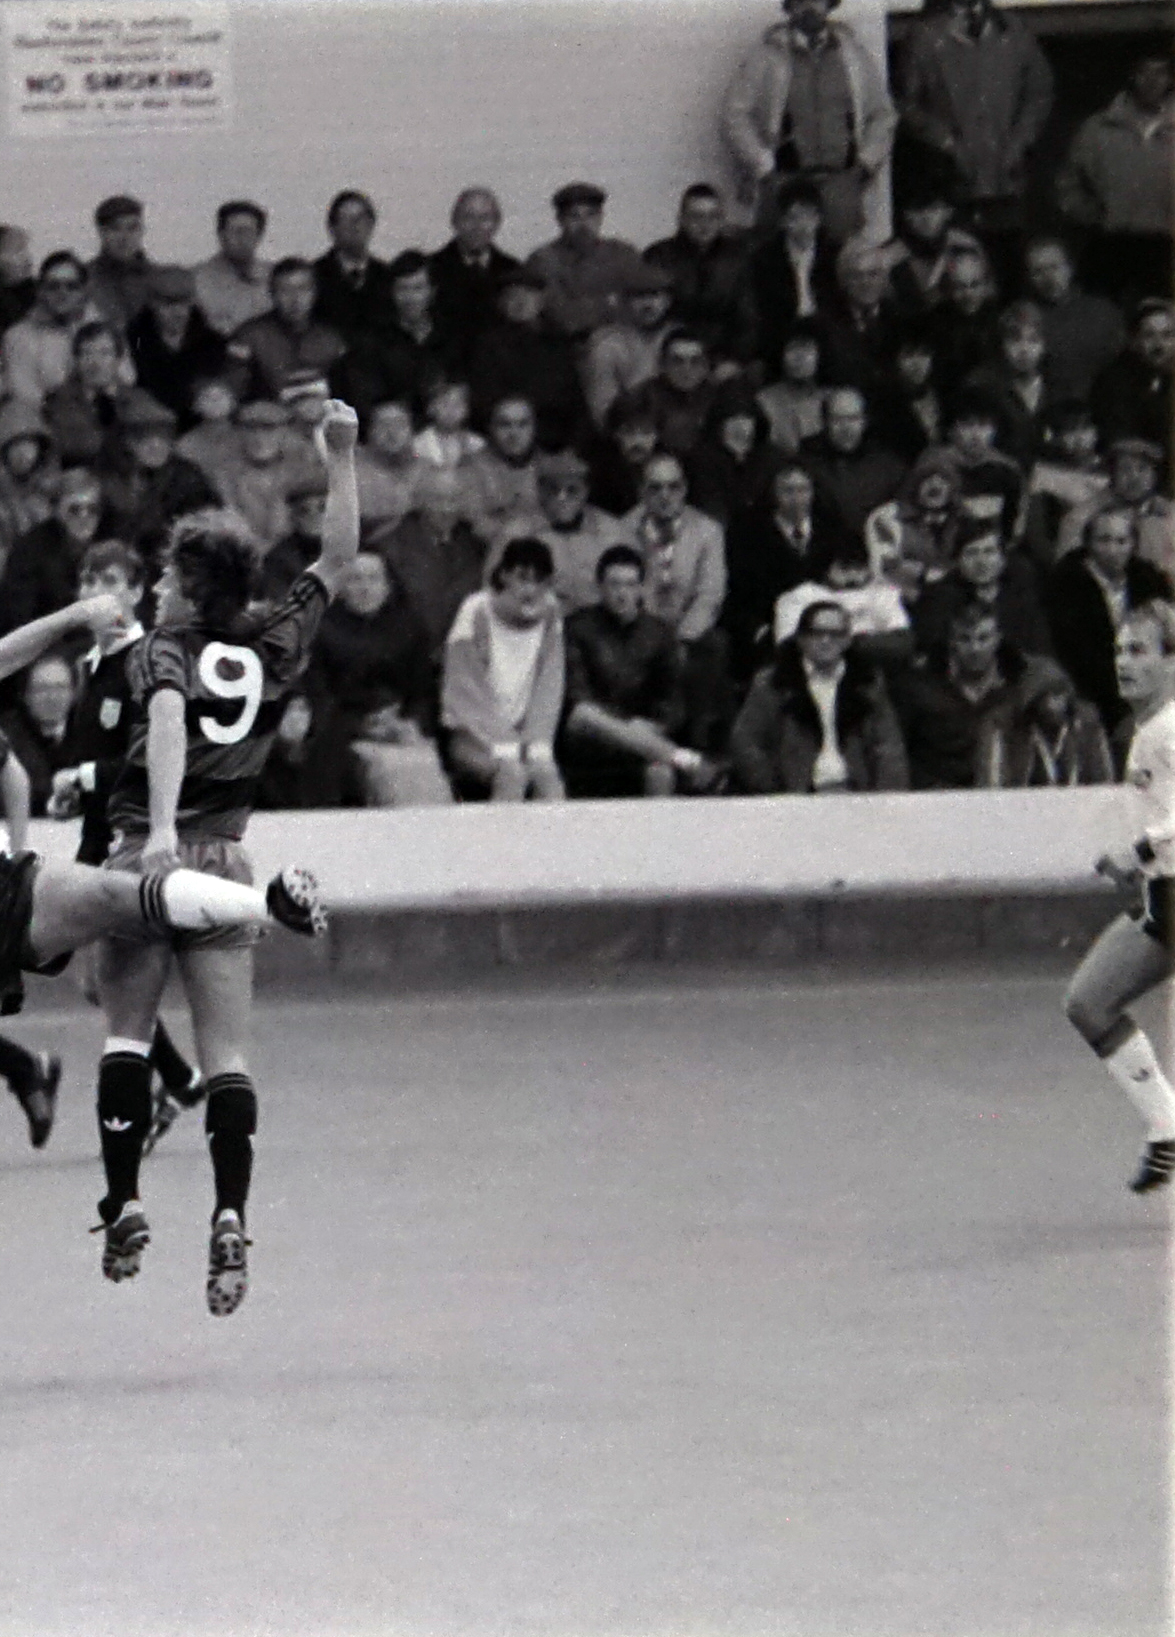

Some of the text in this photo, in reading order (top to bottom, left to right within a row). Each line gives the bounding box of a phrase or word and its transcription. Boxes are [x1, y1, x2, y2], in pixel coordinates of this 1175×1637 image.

[26, 69, 213, 94] NO SMOKING
[199, 641, 263, 745] 9
